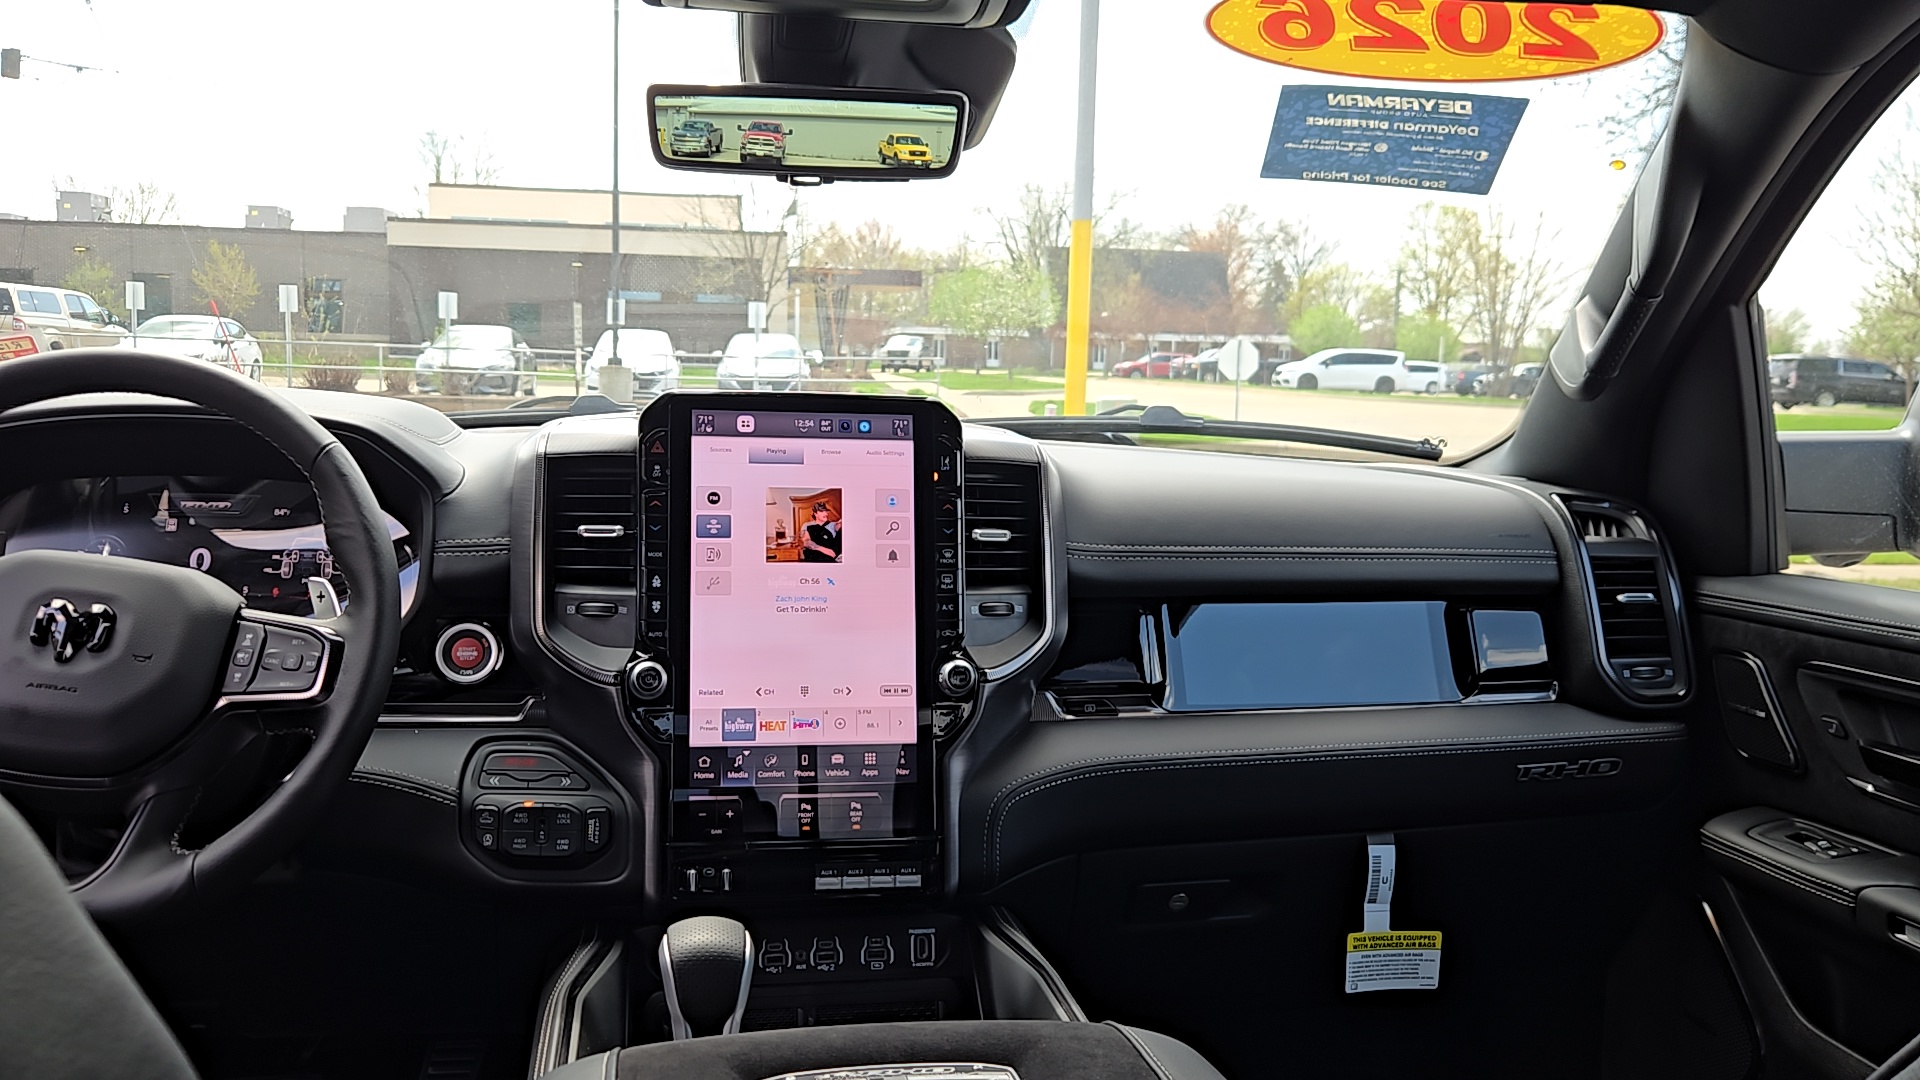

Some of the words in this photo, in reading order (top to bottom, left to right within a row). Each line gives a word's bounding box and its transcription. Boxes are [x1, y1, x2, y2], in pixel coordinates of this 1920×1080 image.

[794, 419, 815, 428] 12:54
[189, 547, 213, 572] 0
[799, 577, 810, 585] Ch
[811, 577, 820, 585] 56
[794, 595, 810, 603] John
[811, 595, 828, 603] King
[800, 605, 828, 613] Drinkin'
[25, 682, 79, 693] AIRBAG
[724, 720, 754, 733] highway
[759, 720, 787, 732] HEAT
[793, 769, 816, 777] Phone
[824, 768, 850, 777] Vehicle
[861, 769, 879, 777] Apps
[896, 767, 910, 776] Nav
[1516, 757, 1623, 781] RHO
[727, 770, 749, 779] Media
[757, 770, 786, 779] Comfort
[1368, 935, 1394, 943] VEHICLE
